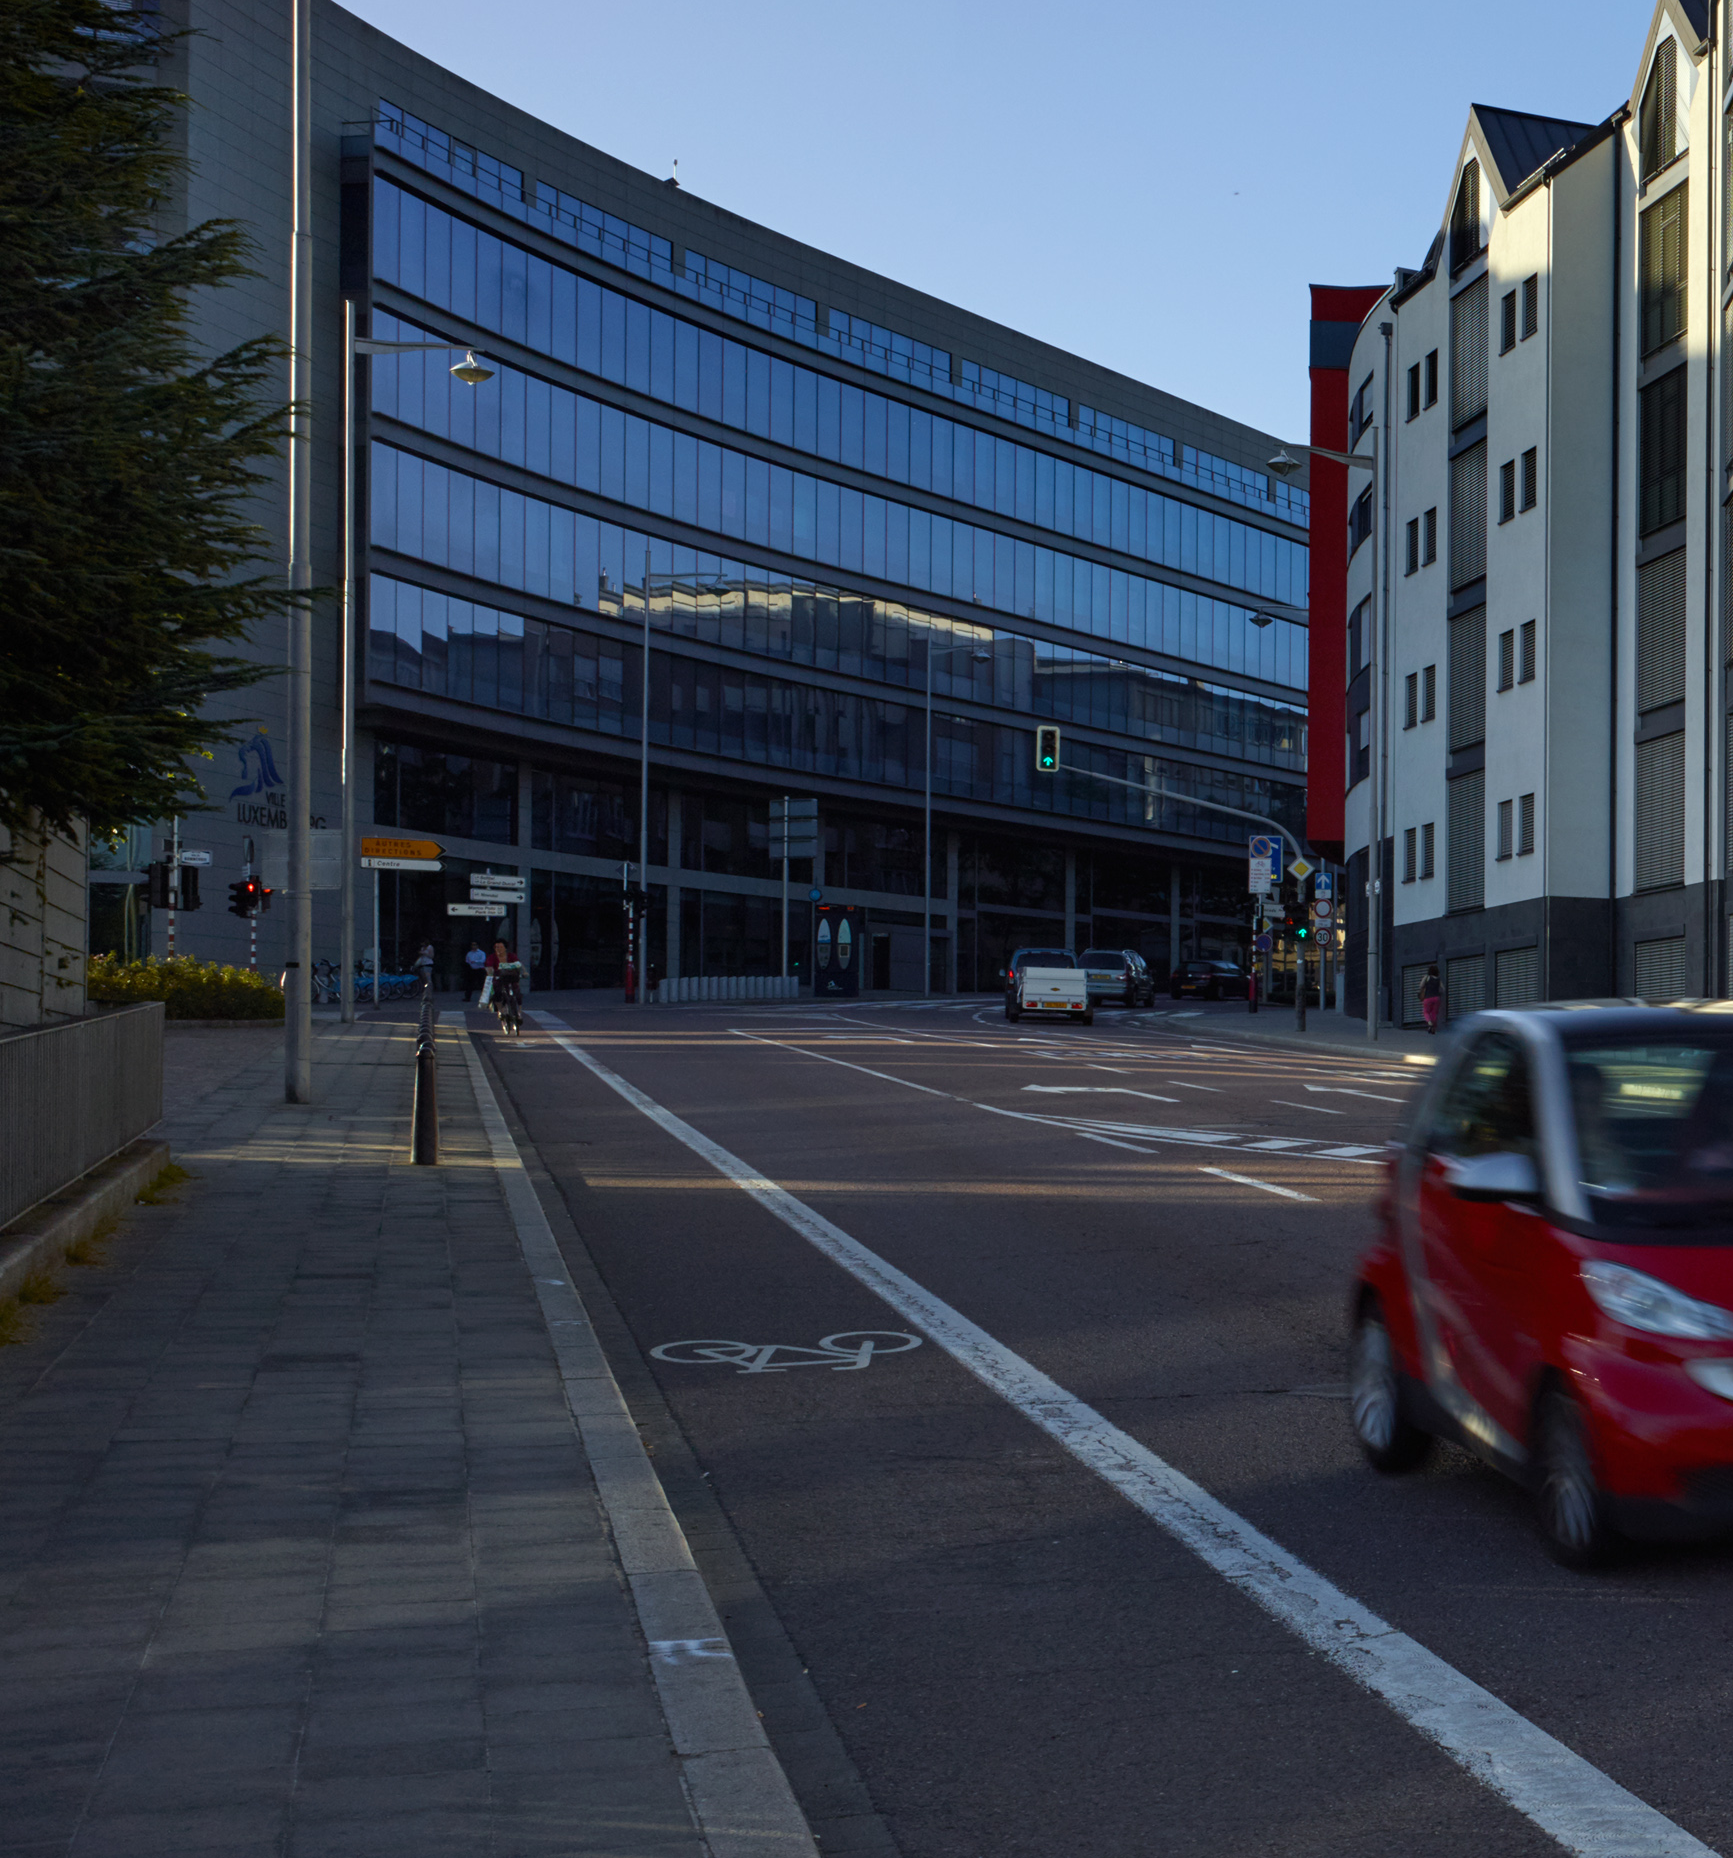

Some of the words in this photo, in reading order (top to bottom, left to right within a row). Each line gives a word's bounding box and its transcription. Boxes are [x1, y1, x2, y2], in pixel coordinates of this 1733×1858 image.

[265, 791, 285, 807] VILLE
[376, 839, 411, 848] AUTRES
[364, 847, 422, 856] DIRECTIONS
[1317, 932, 1328, 942] 30
